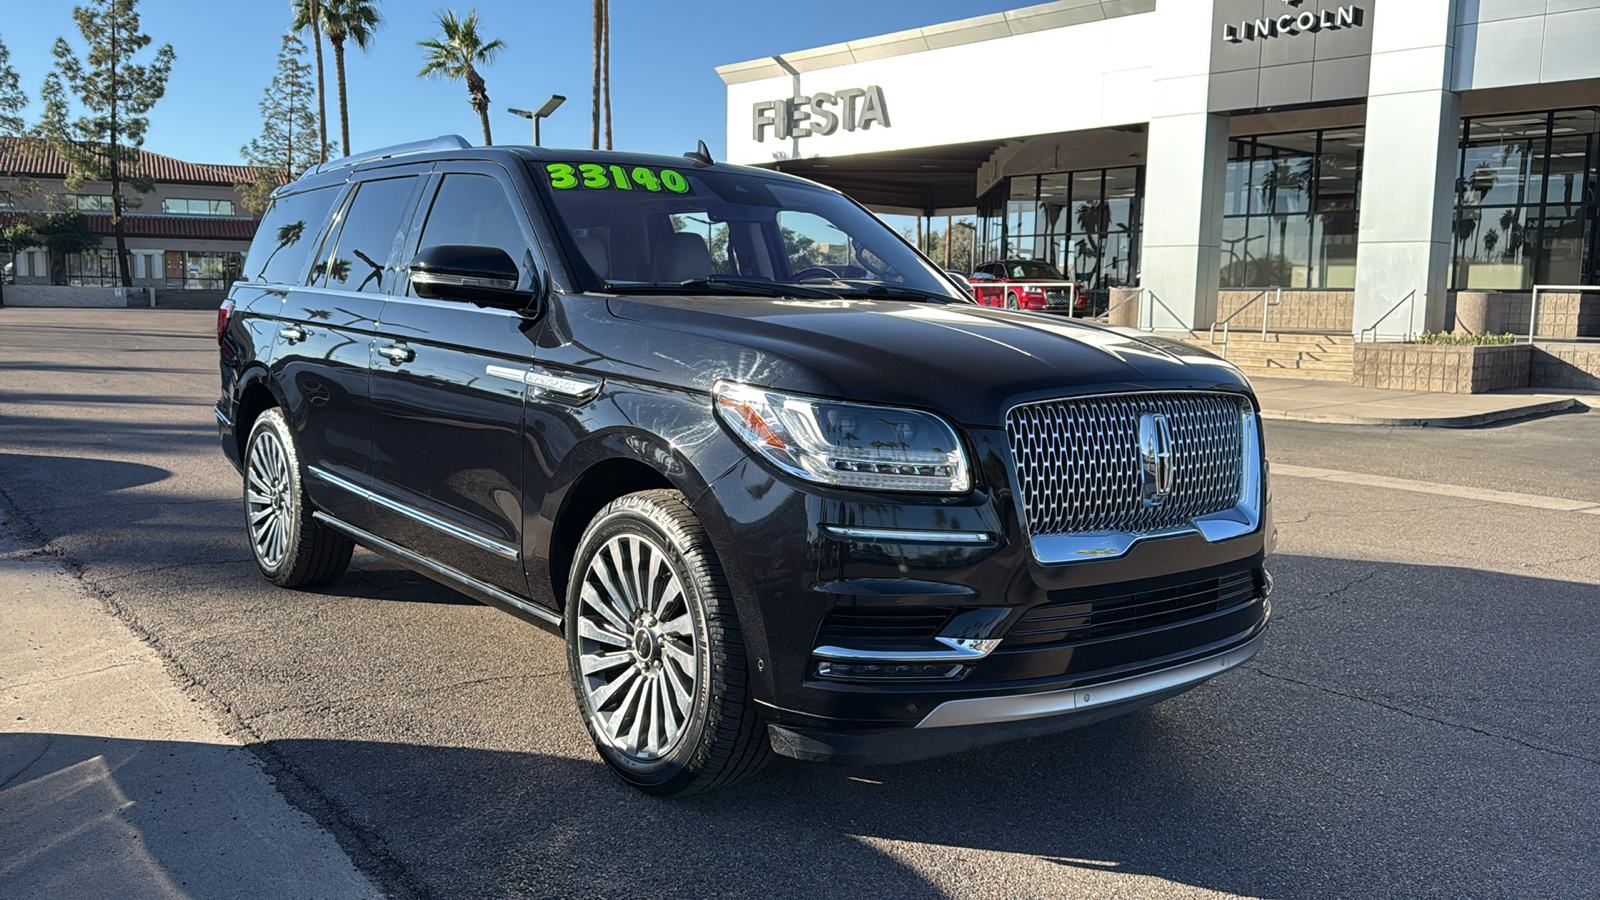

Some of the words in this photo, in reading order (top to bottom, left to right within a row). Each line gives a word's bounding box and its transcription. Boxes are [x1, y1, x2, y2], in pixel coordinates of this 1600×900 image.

[1223, 4, 1356, 42] LINCOLN
[752, 84, 892, 144] FIESTA
[546, 163, 690, 194] 33140
[527, 374, 577, 392] NAVIGATOR
